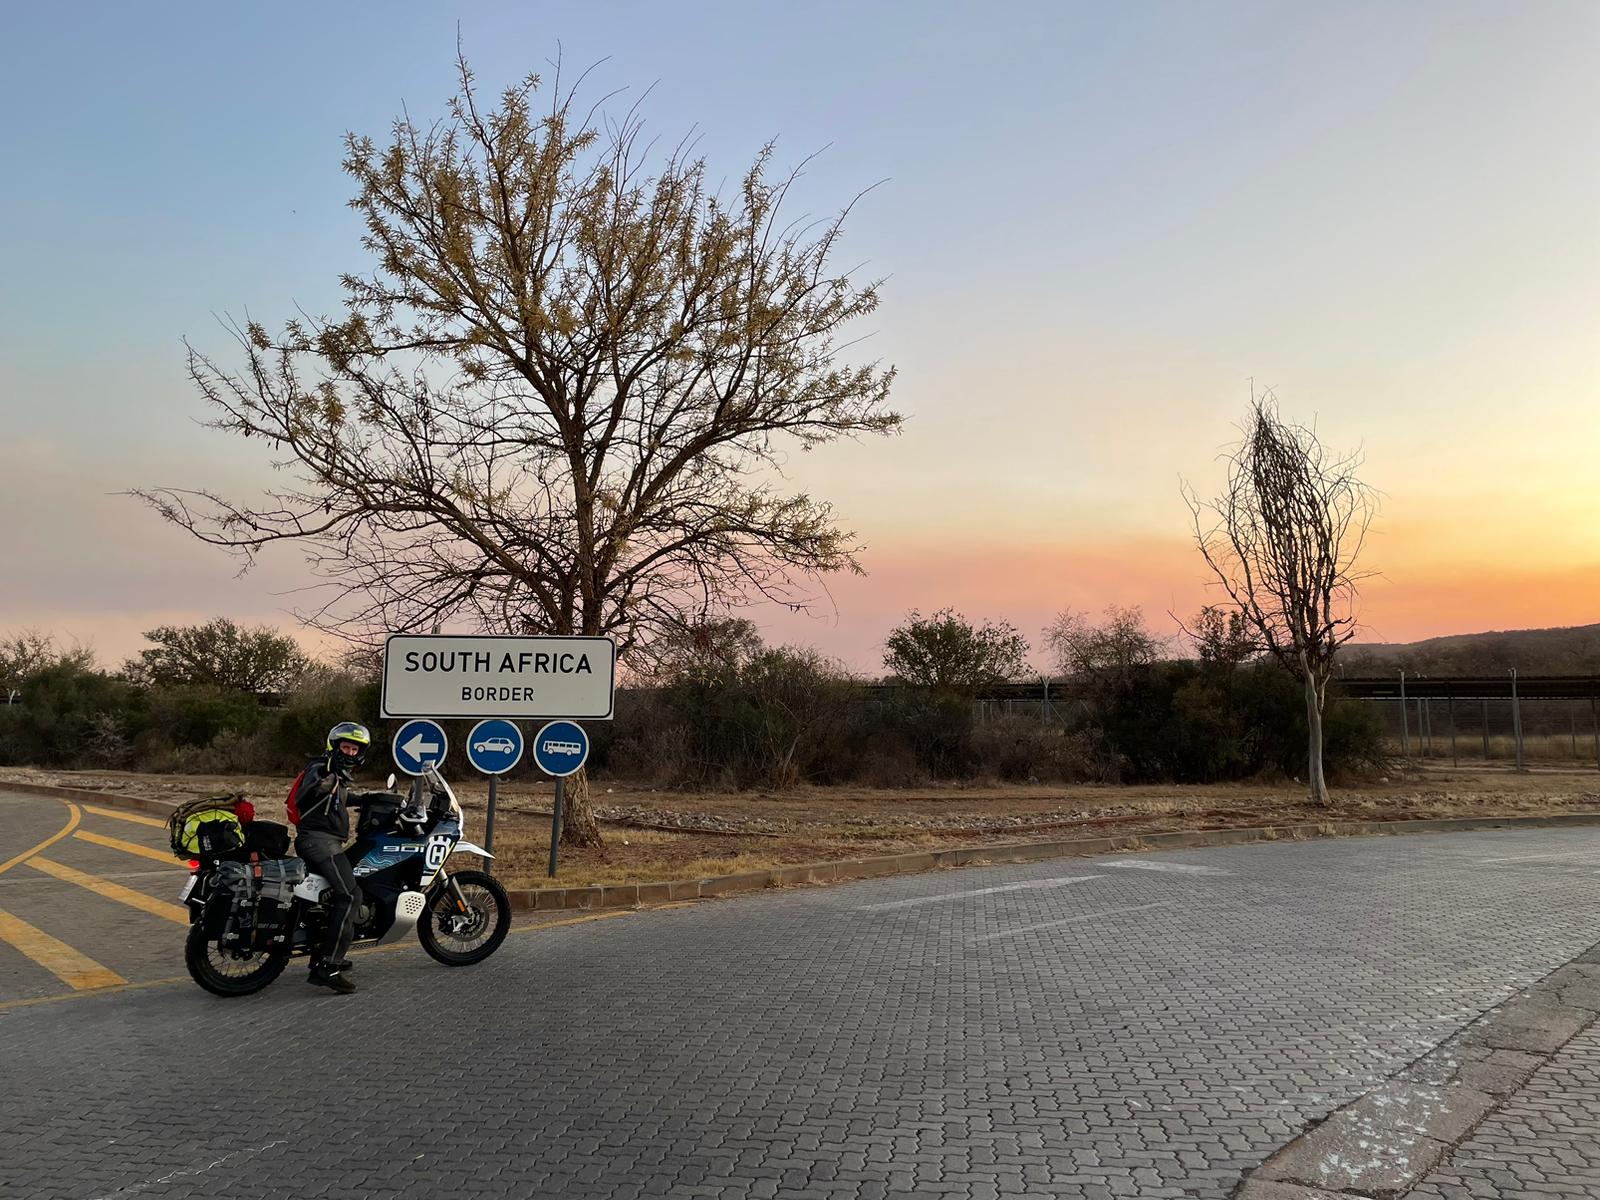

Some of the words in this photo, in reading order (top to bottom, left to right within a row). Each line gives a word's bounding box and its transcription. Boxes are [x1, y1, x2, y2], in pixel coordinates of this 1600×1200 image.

[404, 651, 490, 673] SOUTH
[499, 652, 592, 674] AFRICA
[461, 687, 534, 701] BORDER
